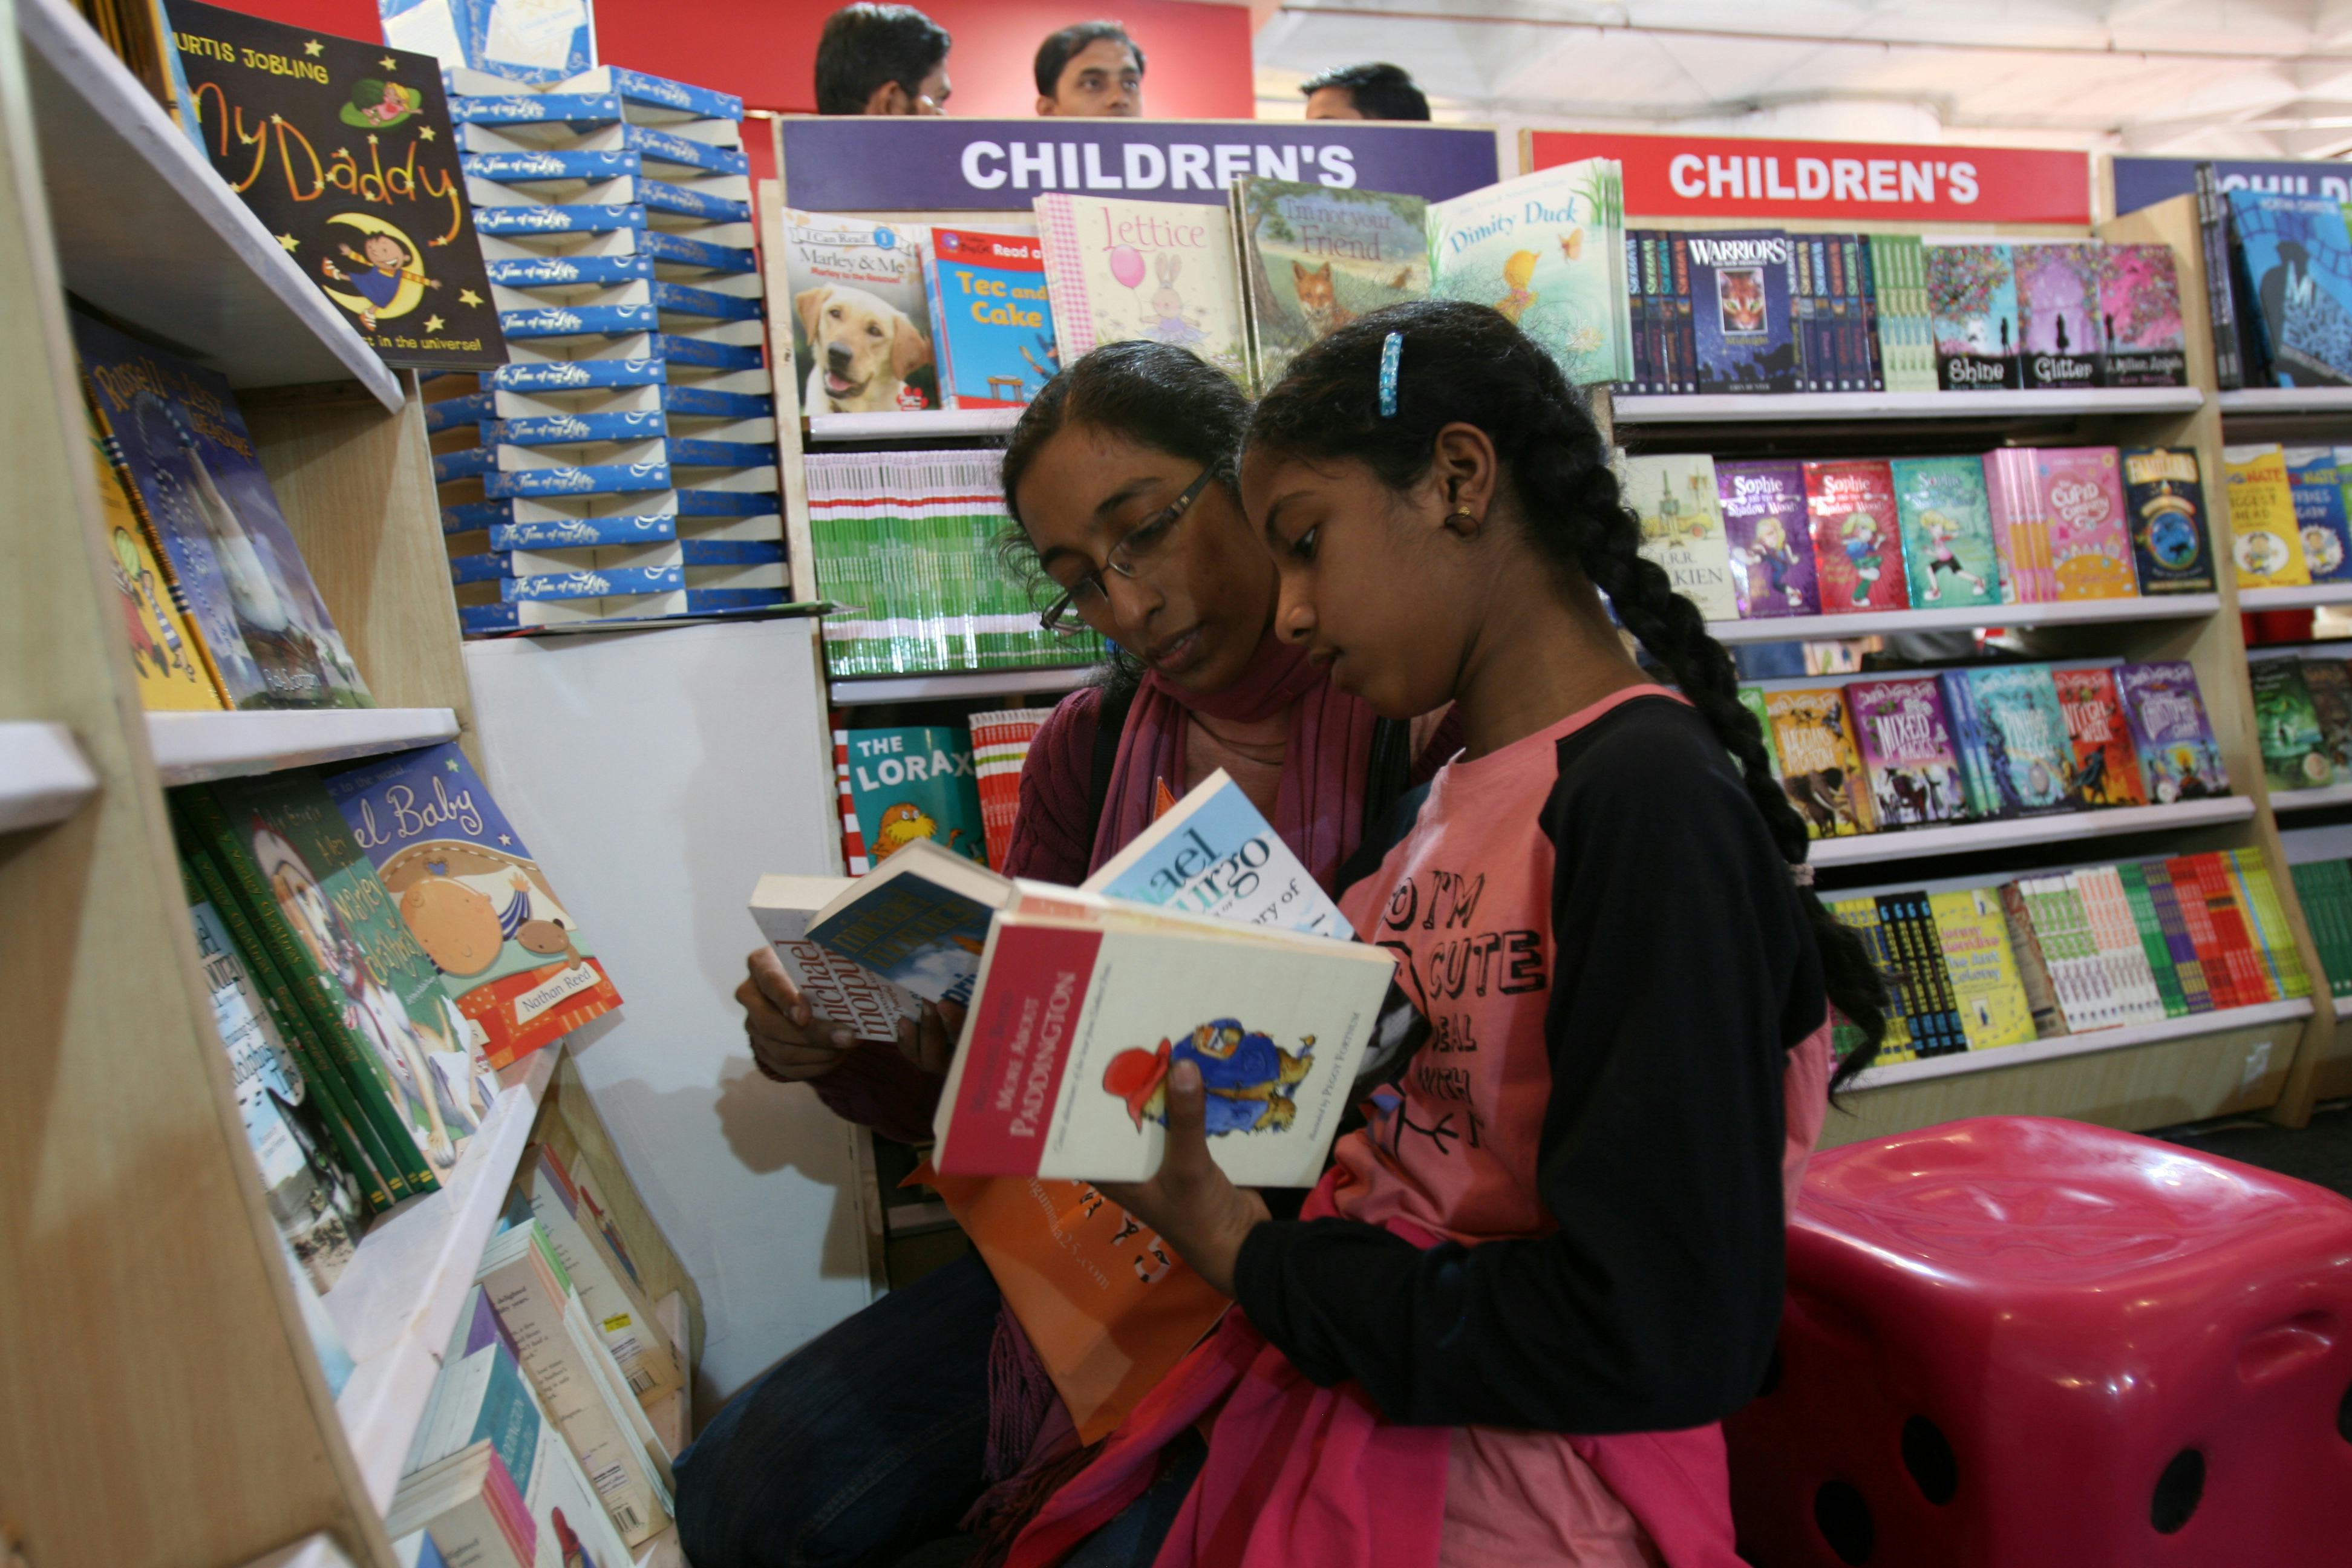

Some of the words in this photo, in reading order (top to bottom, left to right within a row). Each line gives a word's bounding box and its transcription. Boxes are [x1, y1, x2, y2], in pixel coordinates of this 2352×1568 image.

[172, 32, 236, 62] URTIS
[241, 48, 329, 85] JOBLING
[272, 113, 462, 247] Daddy
[961, 140, 1357, 190] CHILDREN'S
[1669, 154, 1979, 204] CHILDREN'S
[1286, 198, 1312, 222] I'm
[1315, 206, 1341, 225] not
[1341, 211, 1391, 232] your
[1450, 212, 1517, 255] Dimity
[1524, 195, 1579, 225] Duck
[817, 233, 836, 243] Can
[992, 243, 1028, 259] Read
[1301, 224, 1383, 262] Friend
[1688, 237, 1787, 266] WARRIORS
[800, 246, 854, 271] Marley
[859, 255, 875, 270] &
[878, 257, 906, 273] Me
[955, 270, 1008, 298] Tec
[1011, 286, 1050, 300] and
[971, 301, 1042, 328] Cake
[377, 335, 393, 347] in
[394, 335, 417, 348] the
[420, 338, 482, 351] universe!
[94, 356, 169, 413] Russell
[1949, 356, 2005, 383] Shine
[2033, 356, 2094, 383] Glitter
[1733, 475, 1784, 497] Sophie
[1822, 475, 1870, 495] Sophie
[1673, 567, 1723, 587] KIEN
[857, 736, 904, 758] THE
[1876, 714, 1930, 760] MIXED
[855, 750, 978, 792] LORAX
[353, 797, 391, 848] el
[386, 775, 483, 838] Baby
[1150, 826, 1224, 892] ael
[1174, 837, 1271, 912] urgo
[1251, 904, 1279, 924] ory
[1281, 878, 1301, 904] of
[1422, 870, 1486, 930] I'M
[1880, 905, 1890, 921] 6
[1893, 903, 1904, 920] 6
[1907, 902, 1917, 918] 6
[1920, 900, 1931, 916] 6
[1428, 929, 1547, 1001] CUTE
[520, 981, 565, 1013] Nathan
[562, 966, 592, 995] Reed
[941, 973, 976, 1007] pri
[232, 1042, 276, 1086] dolphus
[996, 1058, 1024, 1112] MORE
[1010, 996, 1040, 1056] ABOUT
[1010, 970, 1077, 1137] PADDINGTON
[1027, 1176, 1110, 1291] nguinindia25.com
